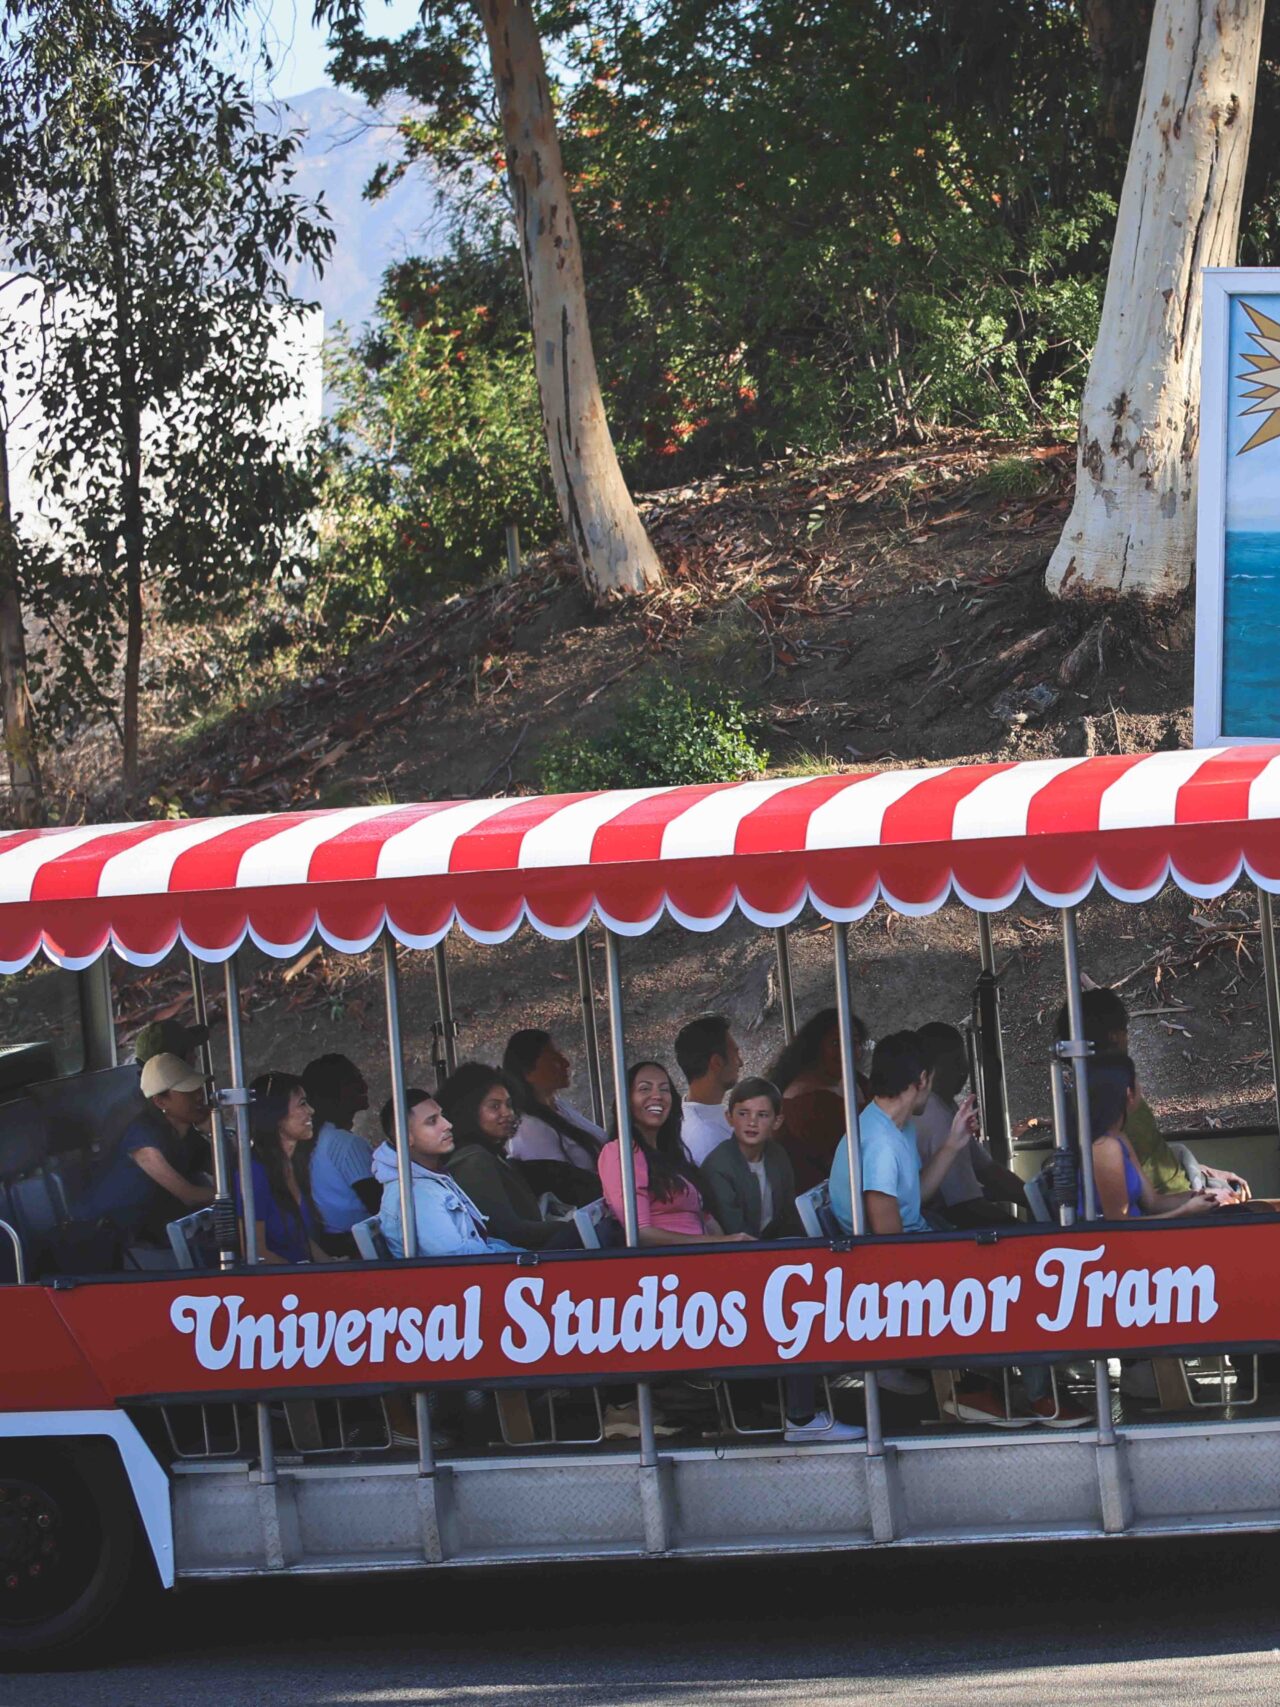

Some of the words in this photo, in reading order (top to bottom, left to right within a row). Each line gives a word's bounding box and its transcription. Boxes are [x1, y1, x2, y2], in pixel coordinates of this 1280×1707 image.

[170, 1285, 483, 1370] Universal
[501, 1273, 748, 1364] Studios
[762, 1262, 1022, 1360] Glamor
[1035, 1244, 1219, 1332] Tram
